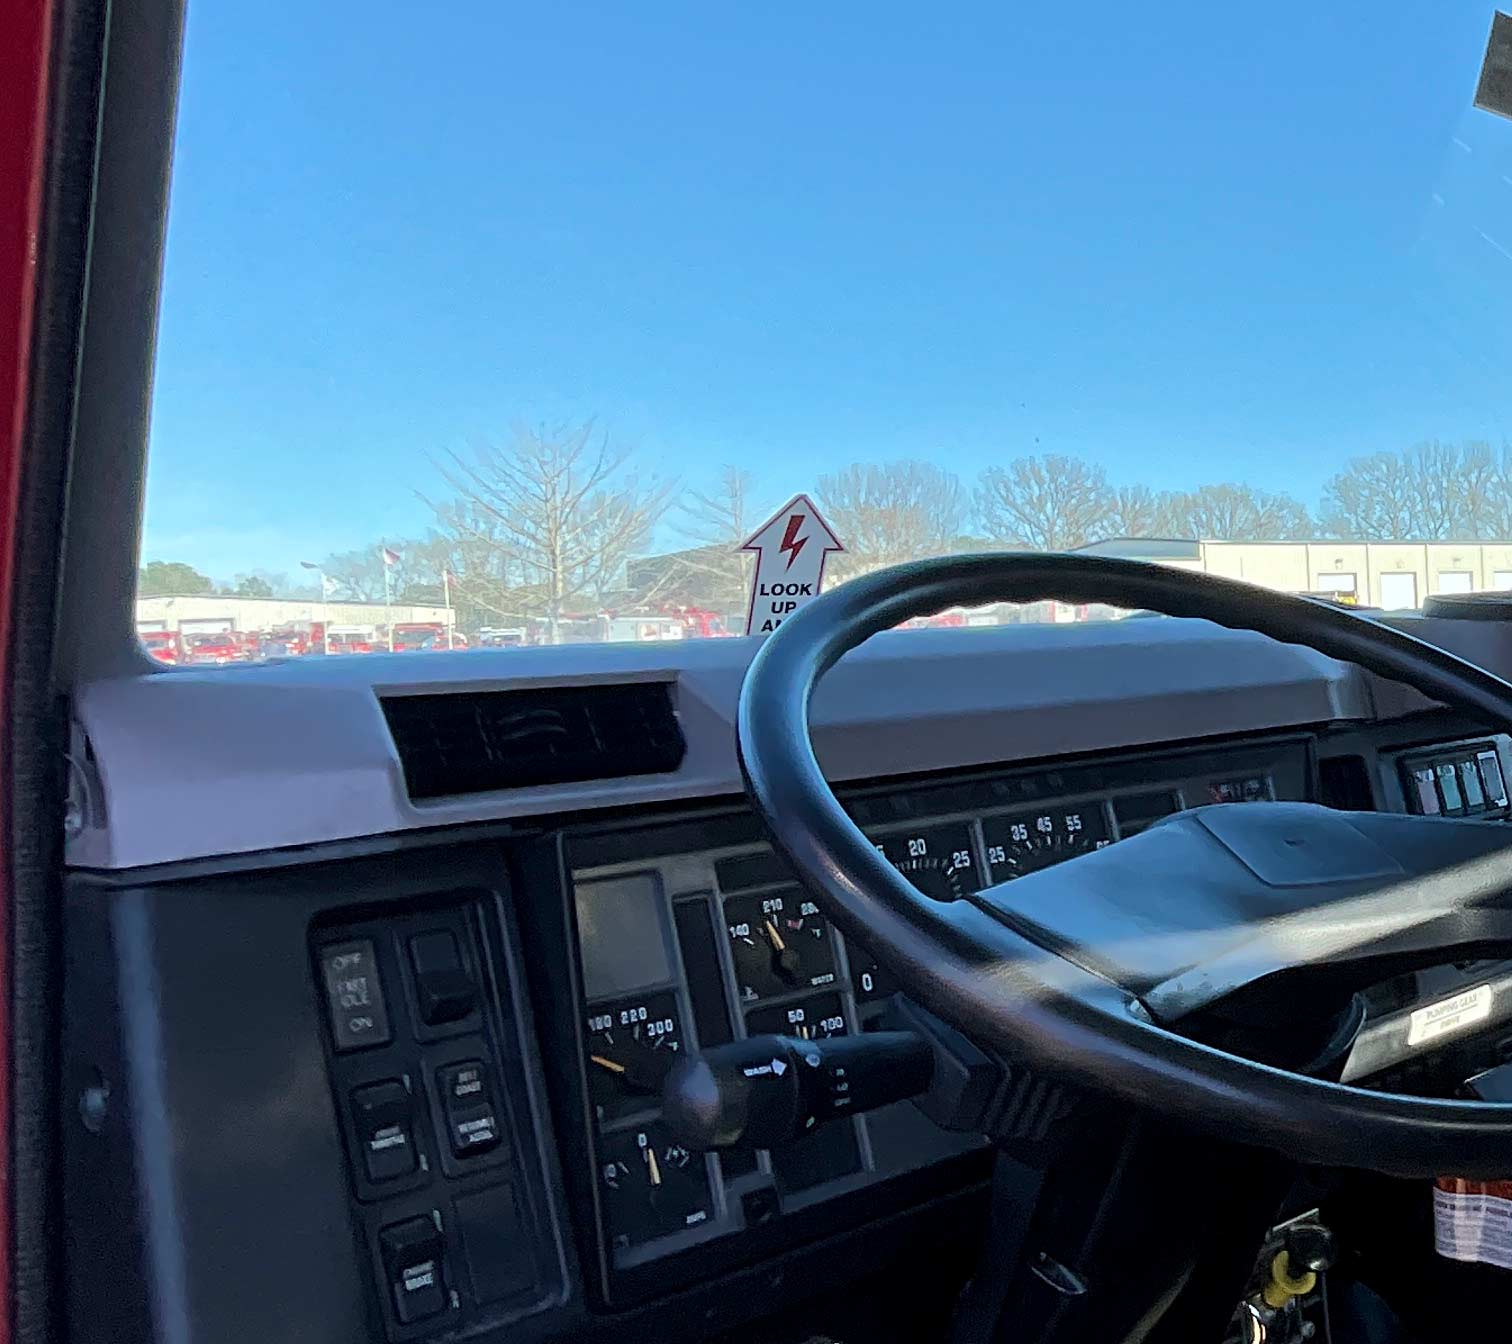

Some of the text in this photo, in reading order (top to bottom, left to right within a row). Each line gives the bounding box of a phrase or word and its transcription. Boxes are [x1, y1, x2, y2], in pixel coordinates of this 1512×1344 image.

[760, 583, 812, 596] LOOK
[771, 601, 797, 614] UP
[1065, 814, 1082, 831] 55
[908, 838, 927, 856] 20
[989, 846, 1005, 864] 25
[952, 850, 971, 869] 25
[762, 898, 783, 913] 210
[861, 973, 873, 992] 0
[620, 1006, 648, 1025] 220
[787, 1008, 805, 1024] 50
[819, 1015, 844, 1033] 100
